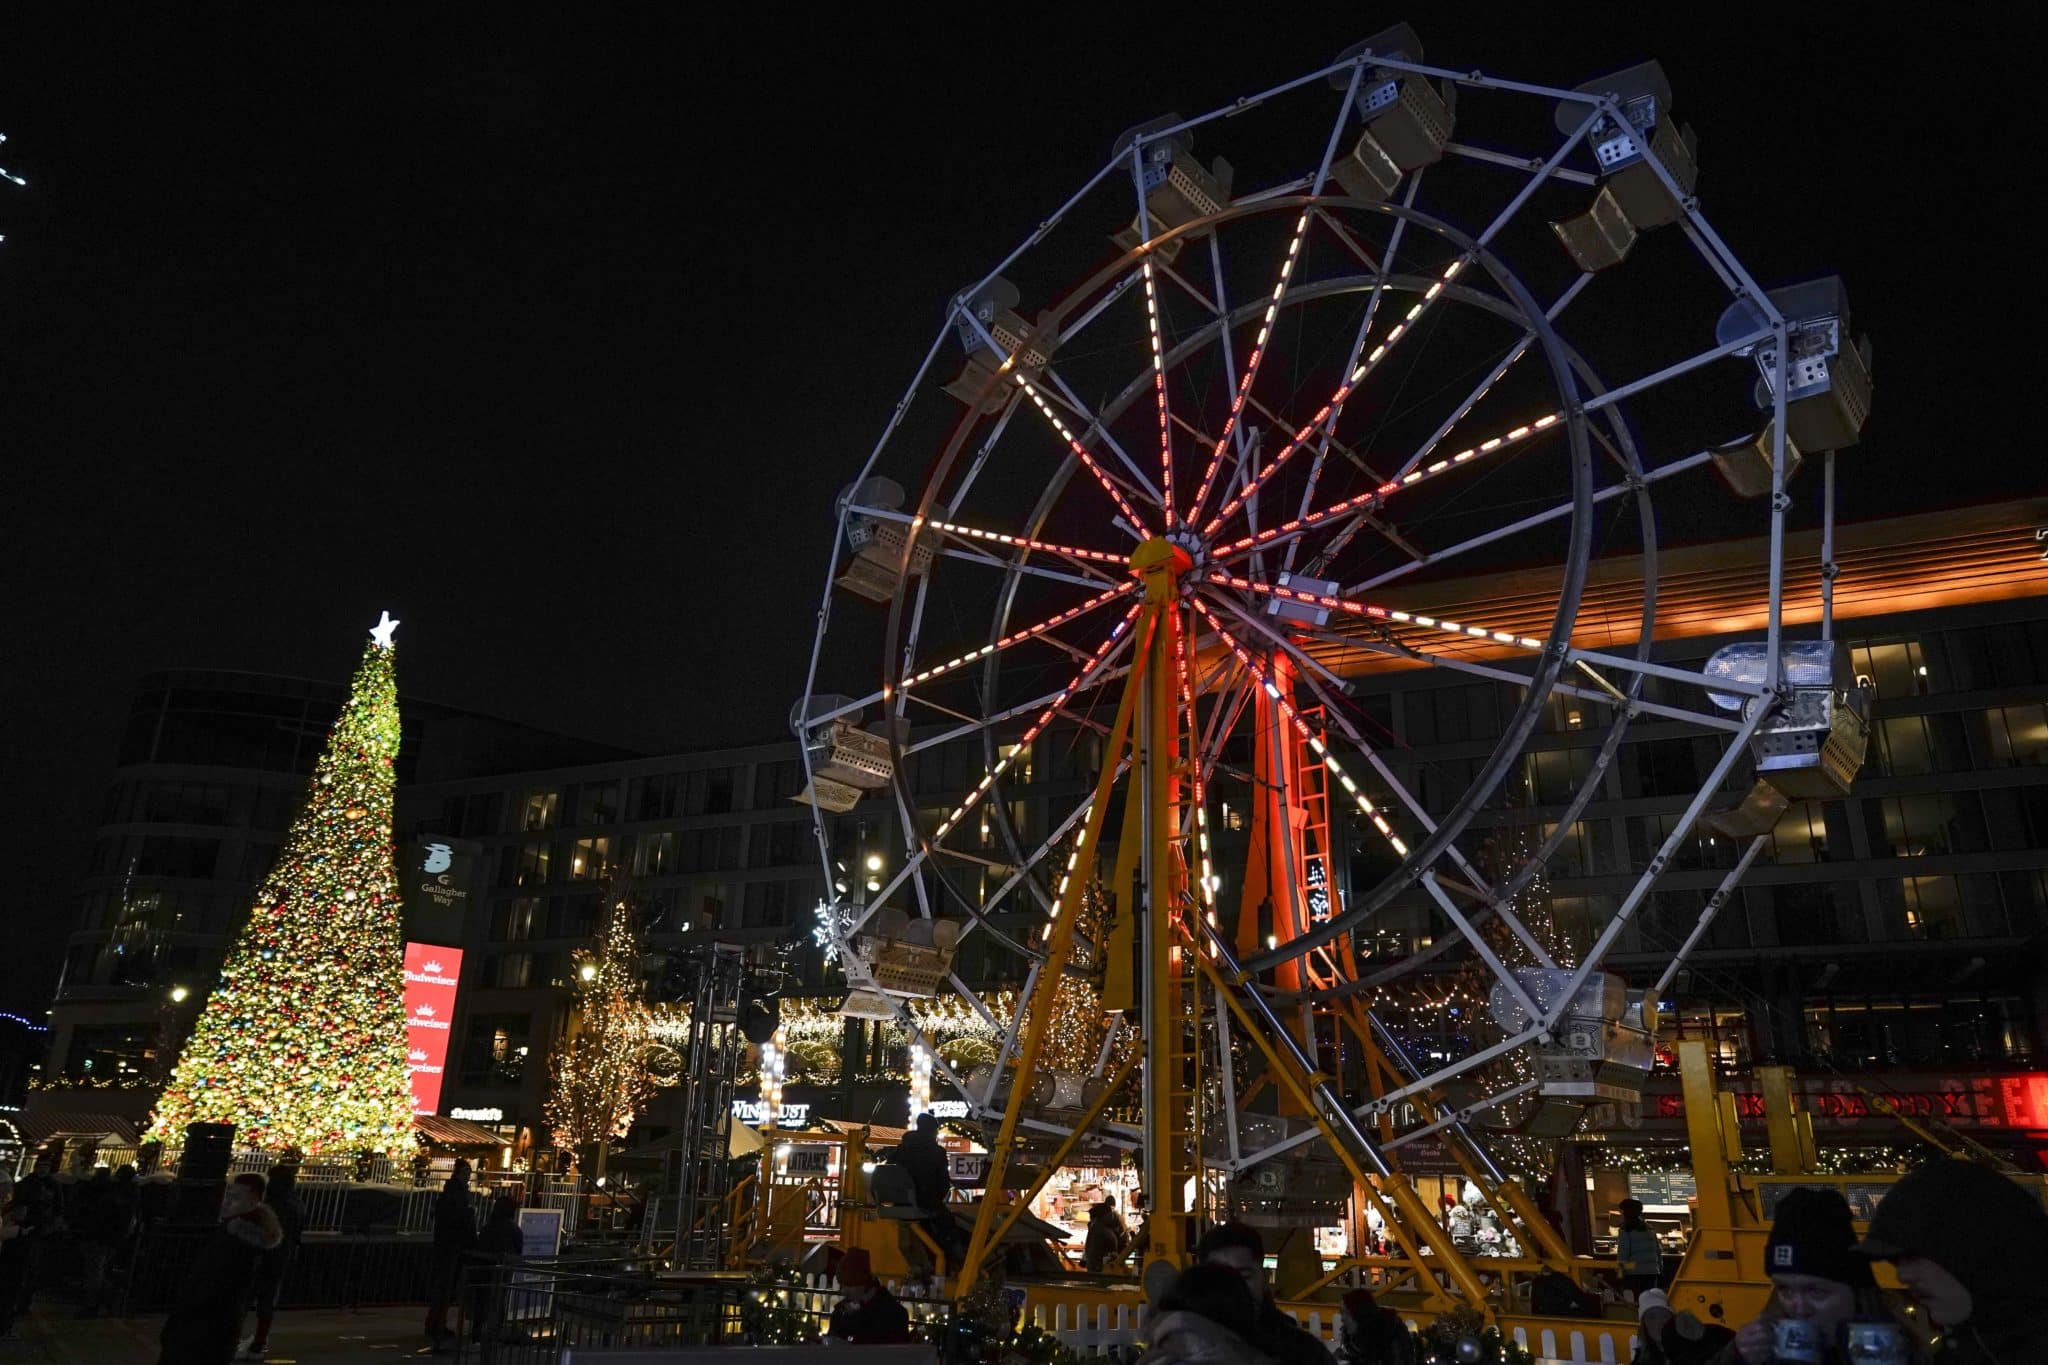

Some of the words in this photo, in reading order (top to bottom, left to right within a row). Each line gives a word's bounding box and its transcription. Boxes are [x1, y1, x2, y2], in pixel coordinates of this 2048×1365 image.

[421, 883, 467, 898] Gallagher
[433, 894, 453, 906] Way
[732, 1100, 810, 1119] WINUST
